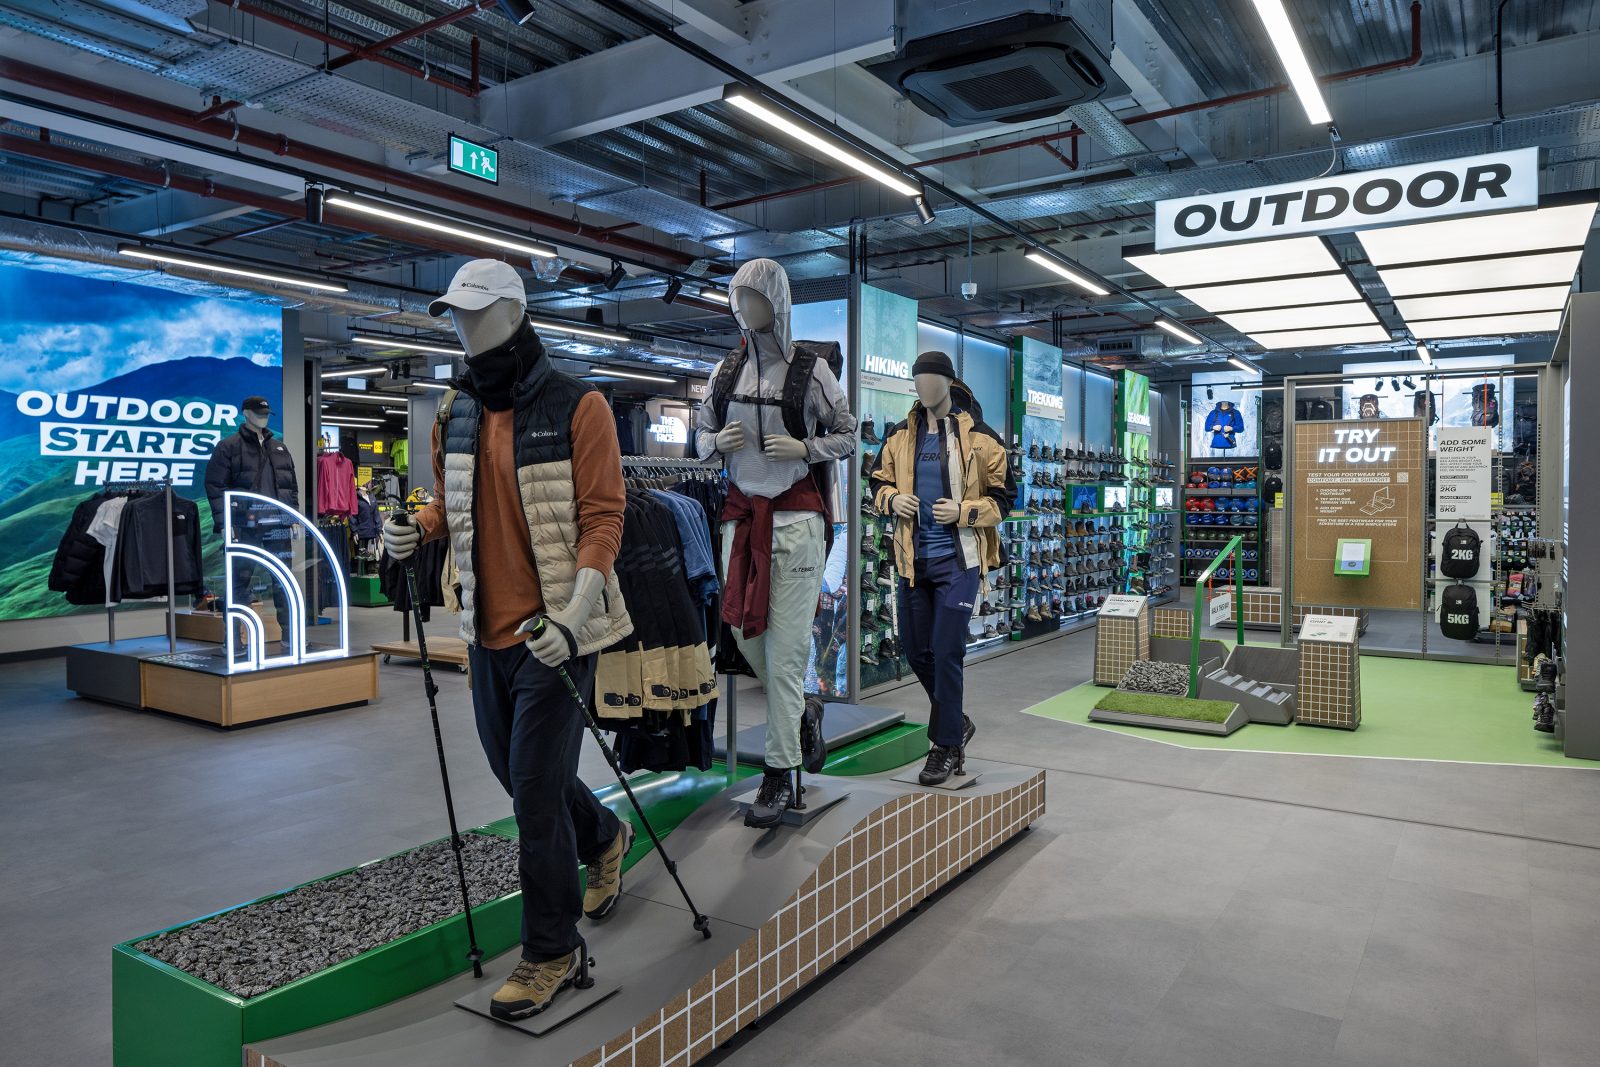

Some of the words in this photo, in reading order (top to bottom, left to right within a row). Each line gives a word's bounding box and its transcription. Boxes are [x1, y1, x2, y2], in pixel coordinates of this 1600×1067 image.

[1173, 163, 1512, 238] OUTDOOR
[467, 282, 488, 290] Columbia
[865, 354, 908, 378] HIKING
[691, 385, 707, 393] NEVE
[1027, 389, 1064, 409] TREKKING
[16, 390, 239, 426] OUTDOOR
[45, 426, 217, 456] STARTS
[1334, 428, 1380, 444] TRY
[917, 452, 940, 462] TERR
[1318, 448, 1341, 462] IT
[1346, 446, 1396, 462] OUT
[74, 461, 195, 486] HERE
[1451, 549, 1473, 560] 2KG
[1448, 614, 1469, 624] 5KG
